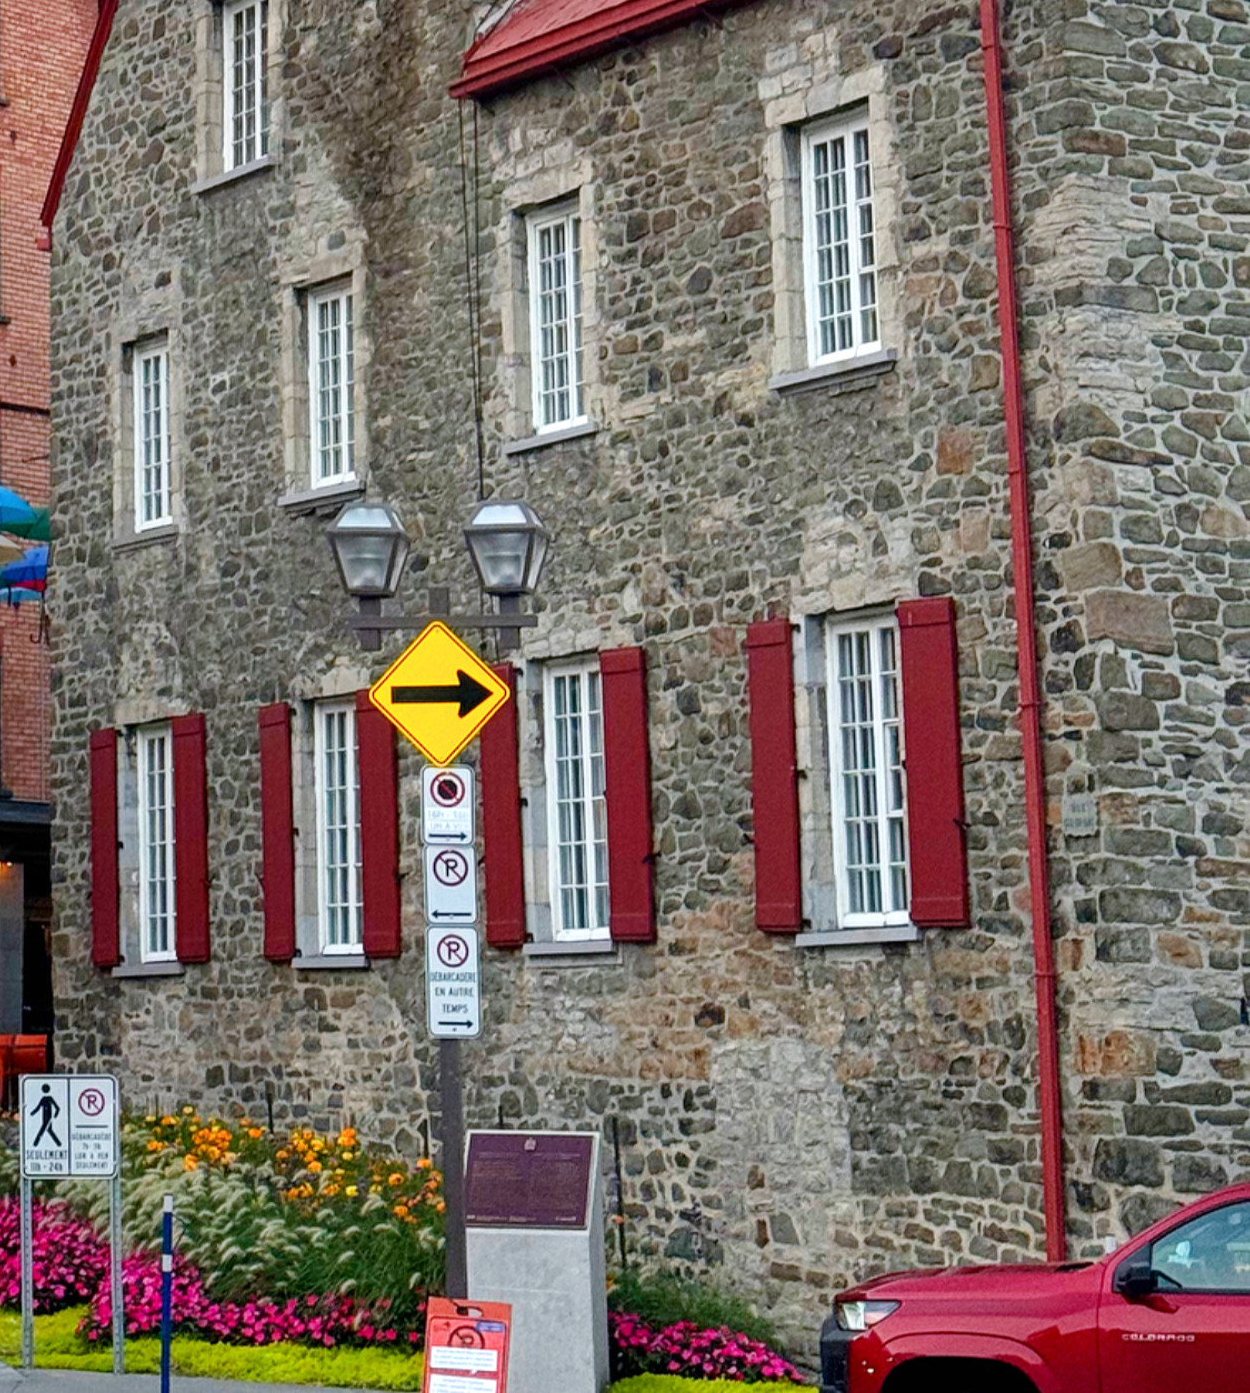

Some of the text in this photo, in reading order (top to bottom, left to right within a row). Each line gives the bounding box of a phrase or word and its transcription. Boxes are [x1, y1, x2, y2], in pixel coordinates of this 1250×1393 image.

[435, 987, 474, 997] EN AUTRE
[442, 1003, 469, 1014] TEMPS
[26, 1150, 67, 1160] SEULEMENT
[1121, 1333, 1196, 1343] COLORADO
